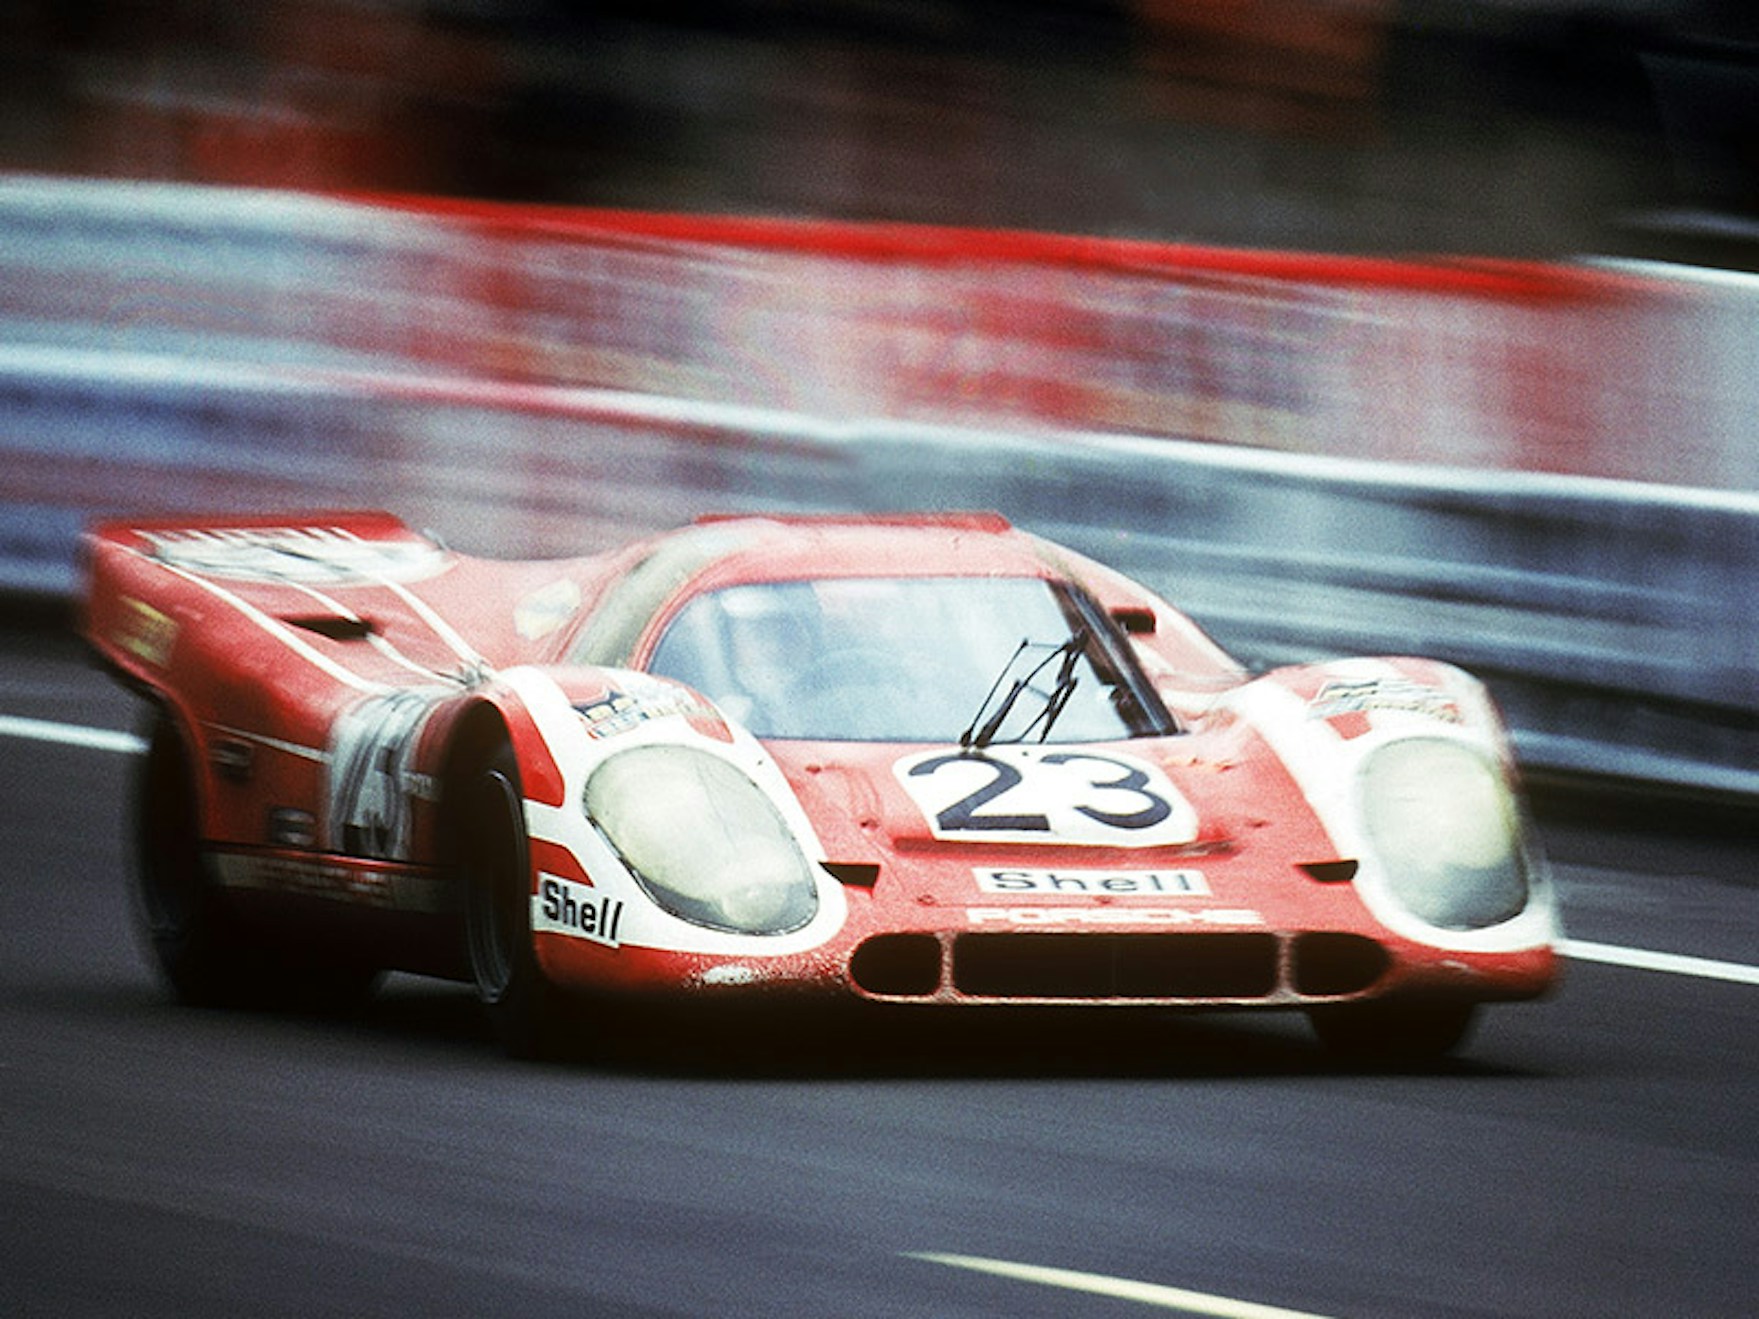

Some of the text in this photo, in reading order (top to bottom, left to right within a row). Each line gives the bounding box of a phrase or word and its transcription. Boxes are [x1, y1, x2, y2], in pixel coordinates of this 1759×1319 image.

[908, 752, 1172, 831] 23
[541, 879, 624, 941] Shell
[990, 871, 1191, 892] Shell
